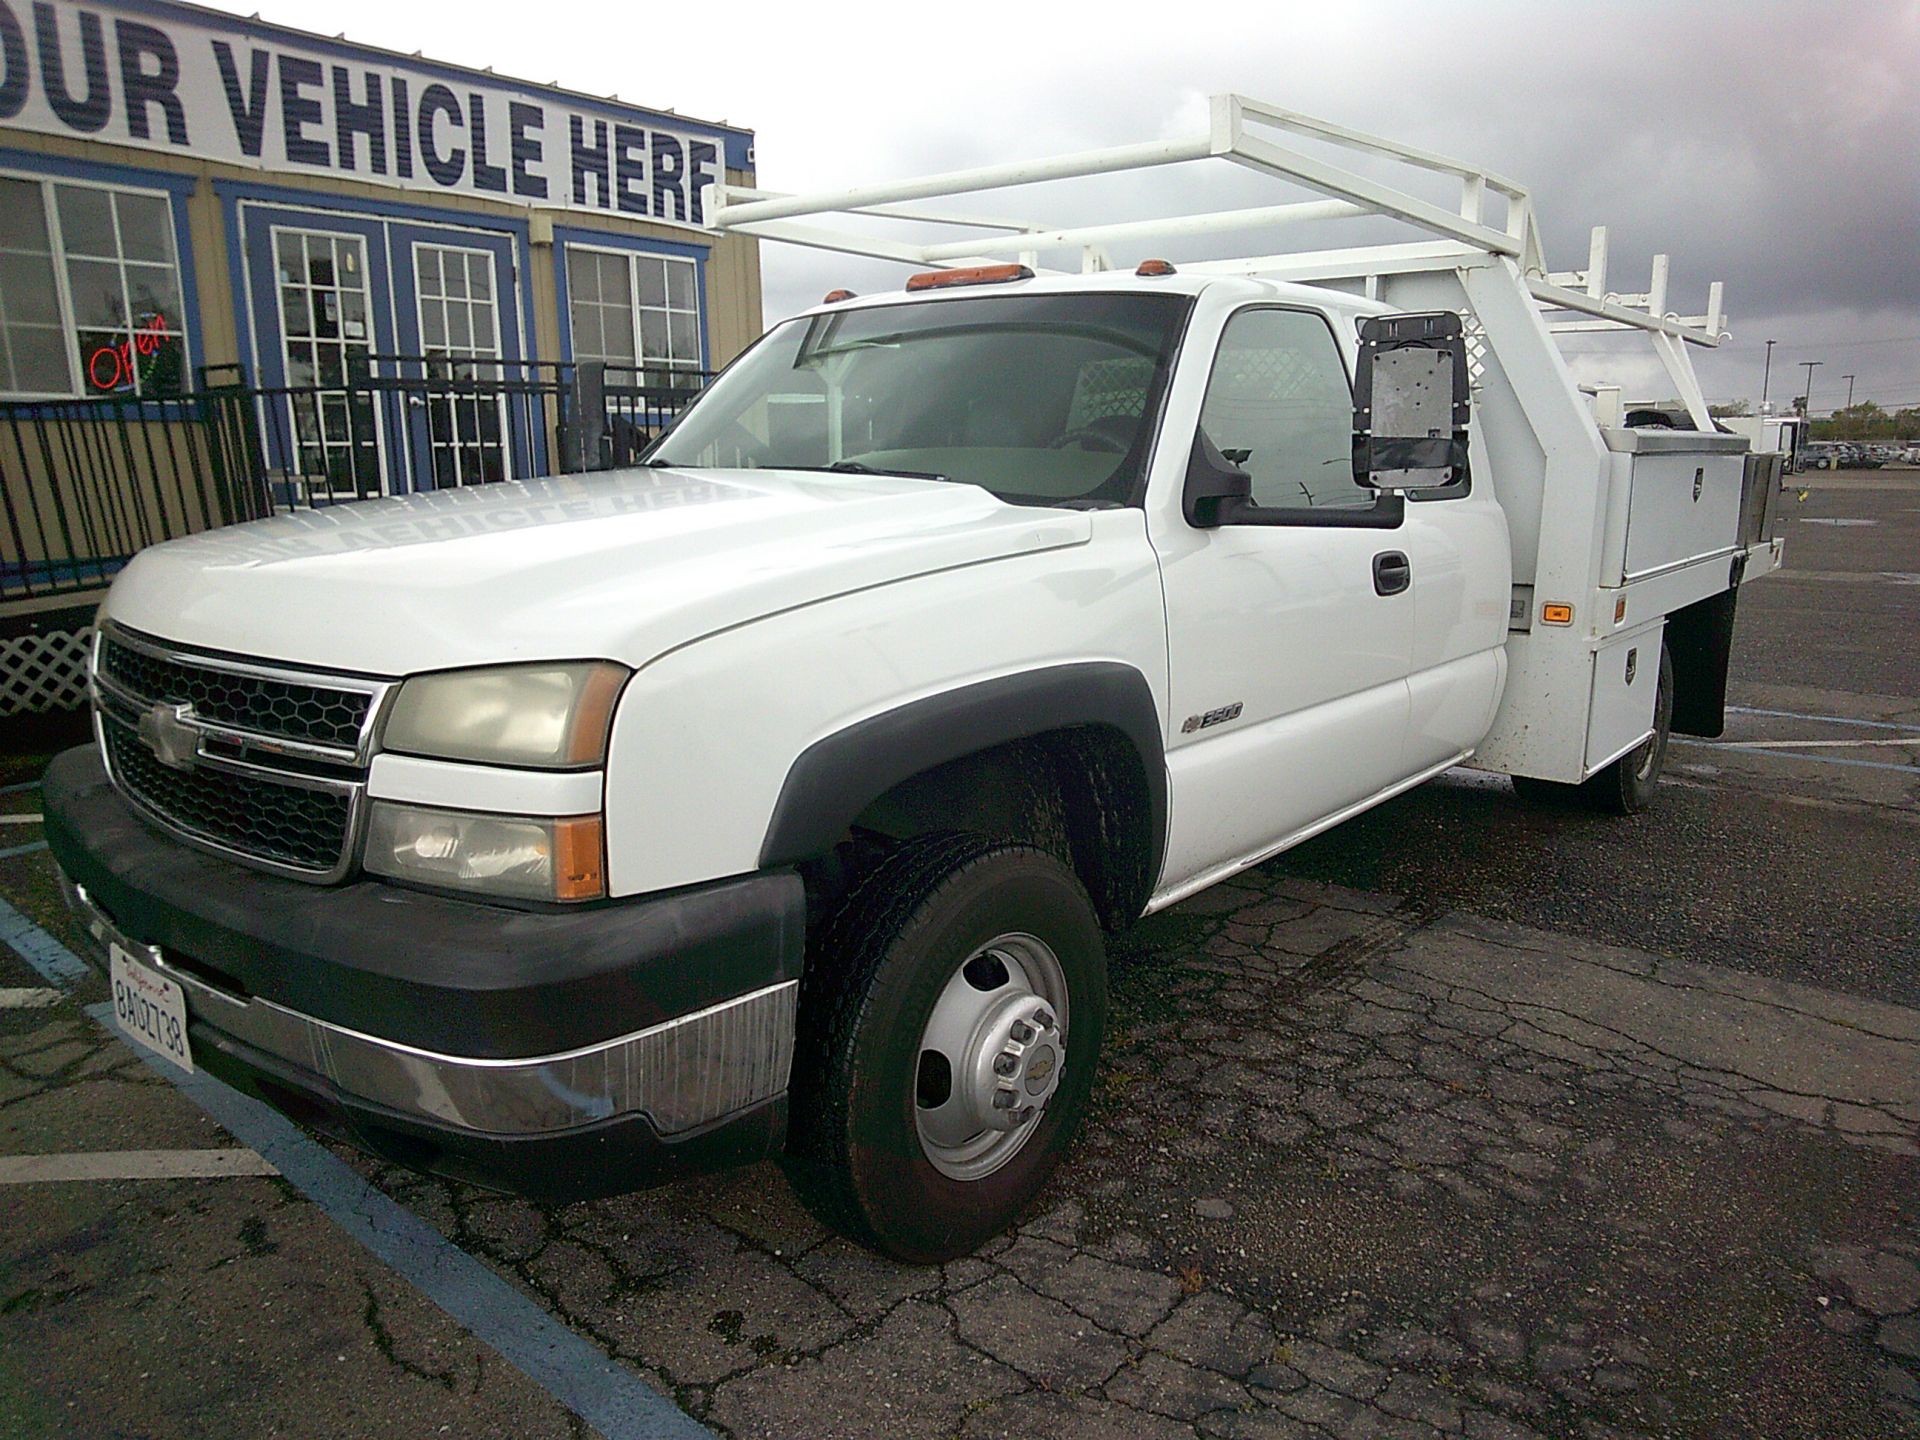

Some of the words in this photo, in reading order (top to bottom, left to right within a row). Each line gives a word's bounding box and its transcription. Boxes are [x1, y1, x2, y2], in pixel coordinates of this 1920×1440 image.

[211, 40, 548, 199] VEHICLE
[570, 114, 717, 224] HERE
[116, 979, 184, 1057] 8A02738
